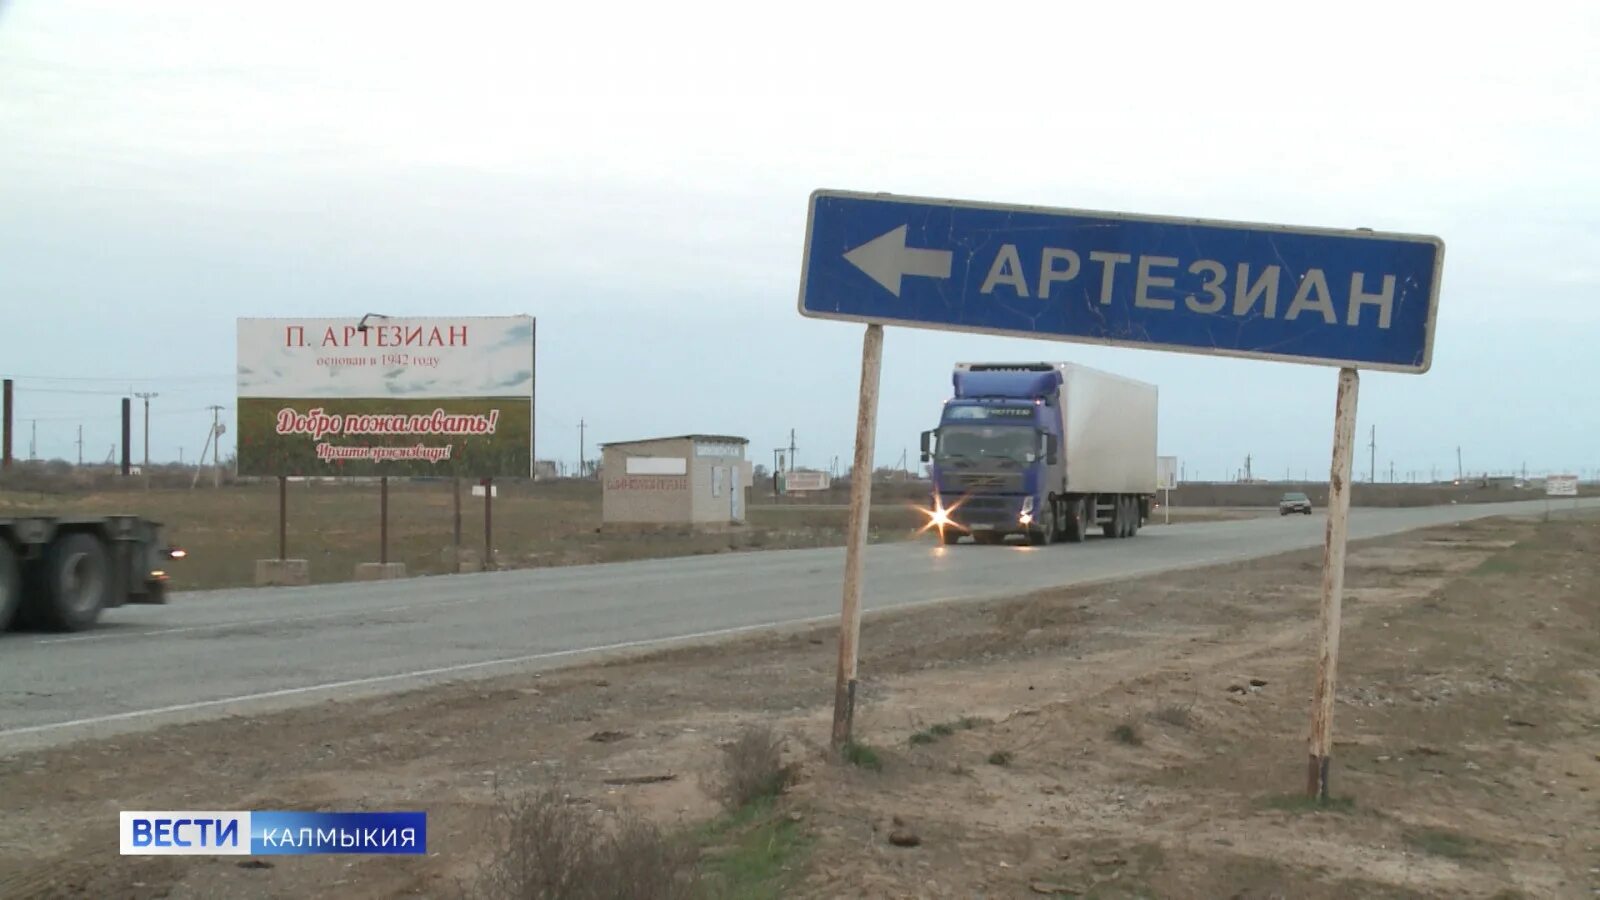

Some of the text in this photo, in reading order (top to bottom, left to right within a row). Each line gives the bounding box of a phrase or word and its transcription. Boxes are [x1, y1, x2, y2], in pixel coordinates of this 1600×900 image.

[979, 242, 1398, 329] АРТЕЗИАН
[285, 325, 469, 348] П. АРТЕЗИАН
[316, 353, 440, 369] основан в 1942 году
[277, 408, 499, 439] Добро пожаловать!
